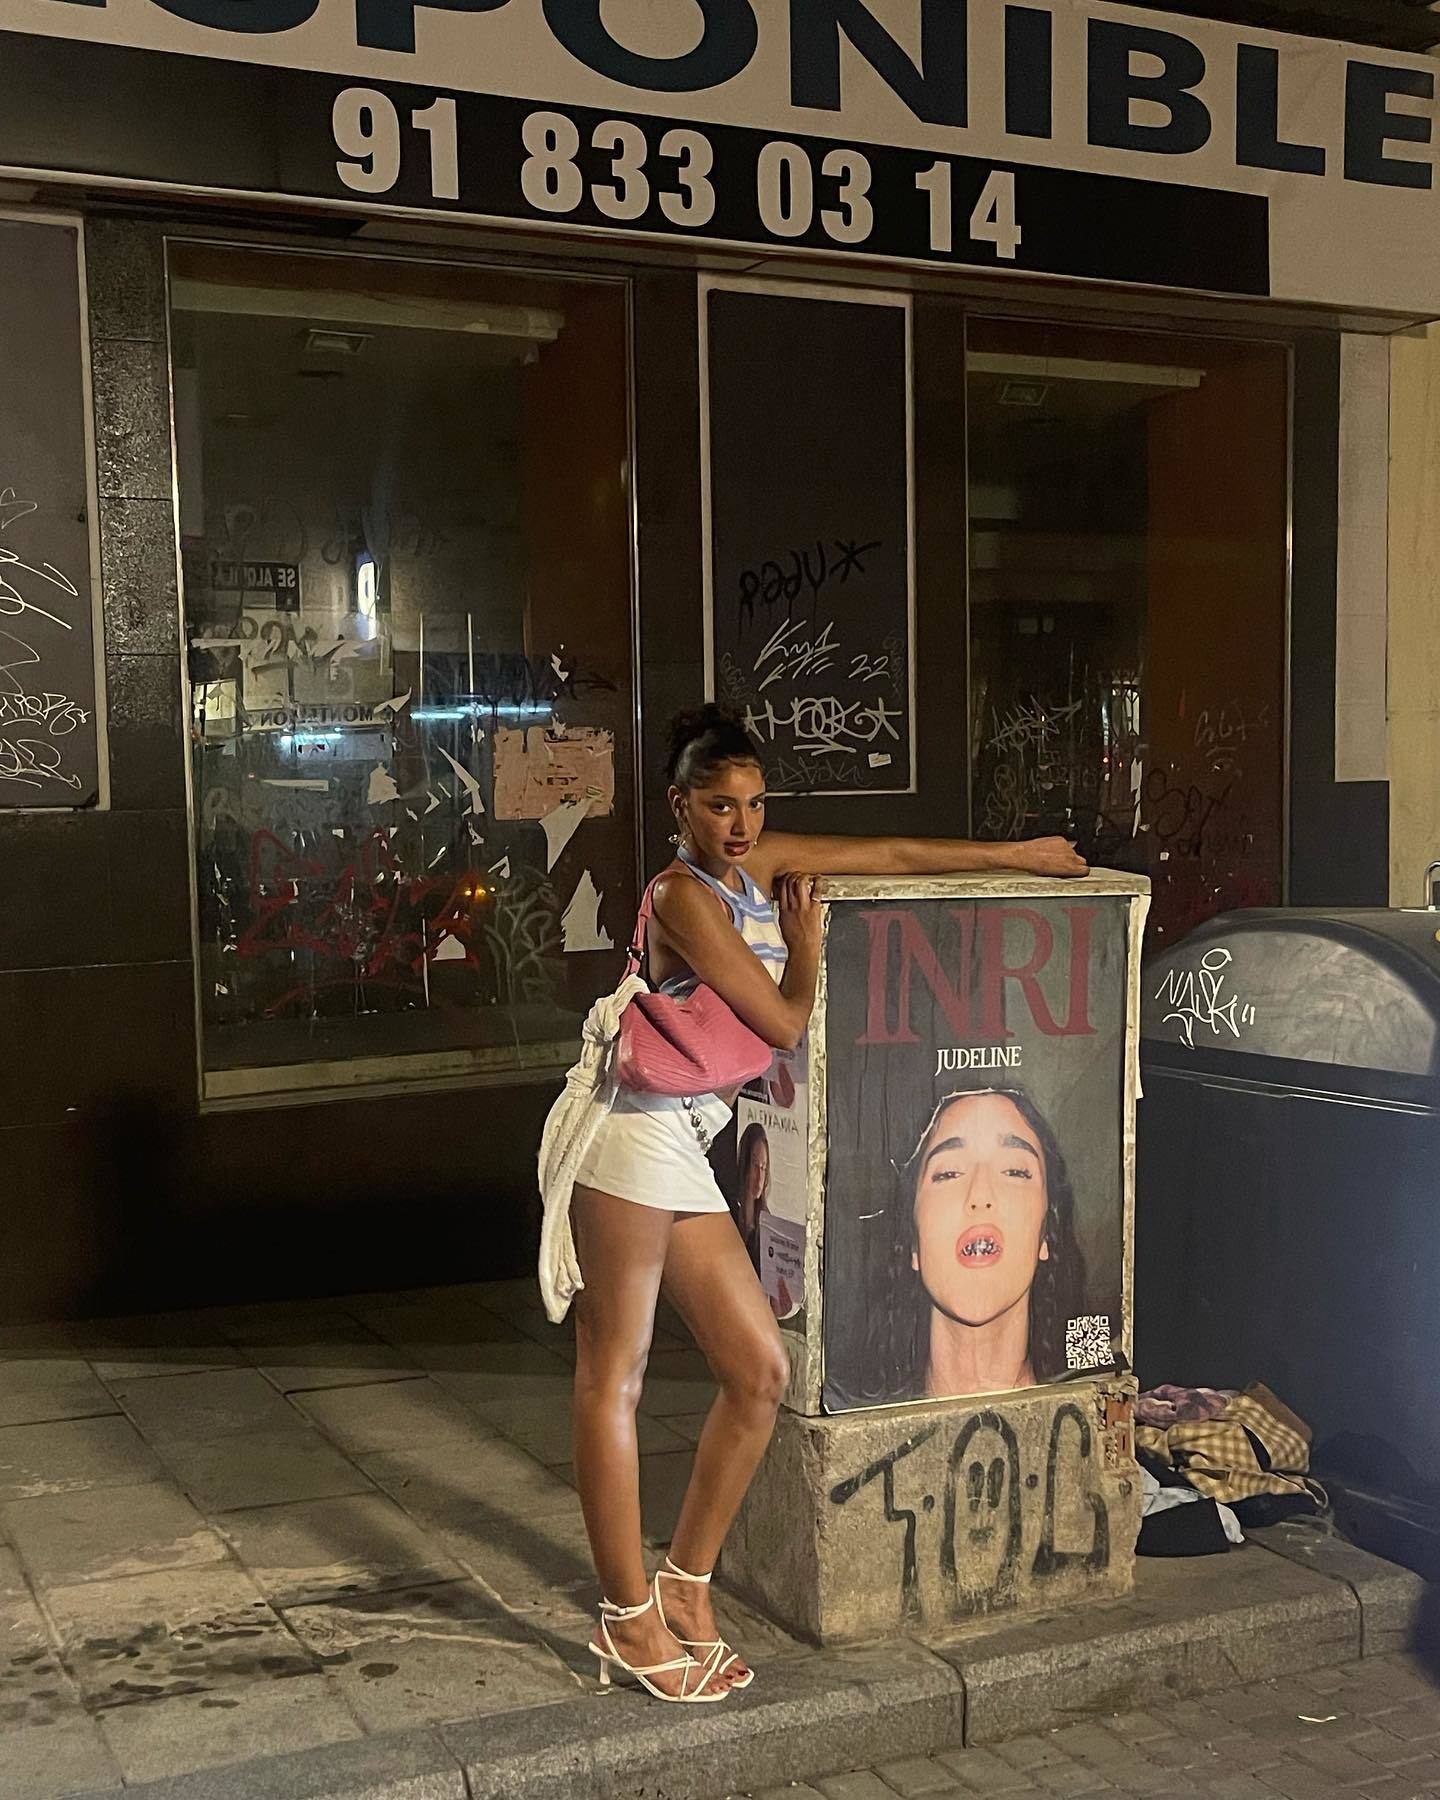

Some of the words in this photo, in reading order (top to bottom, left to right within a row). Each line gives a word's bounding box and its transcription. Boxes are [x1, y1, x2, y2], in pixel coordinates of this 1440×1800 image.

[332, 87, 460, 200] 91
[520, 110, 717, 227] 833
[757, 140, 874, 244] 03
[915, 161, 1022, 260] 14
[855, 905, 1100, 1046] INRI
[933, 1046, 1023, 1077] JUDELINE
